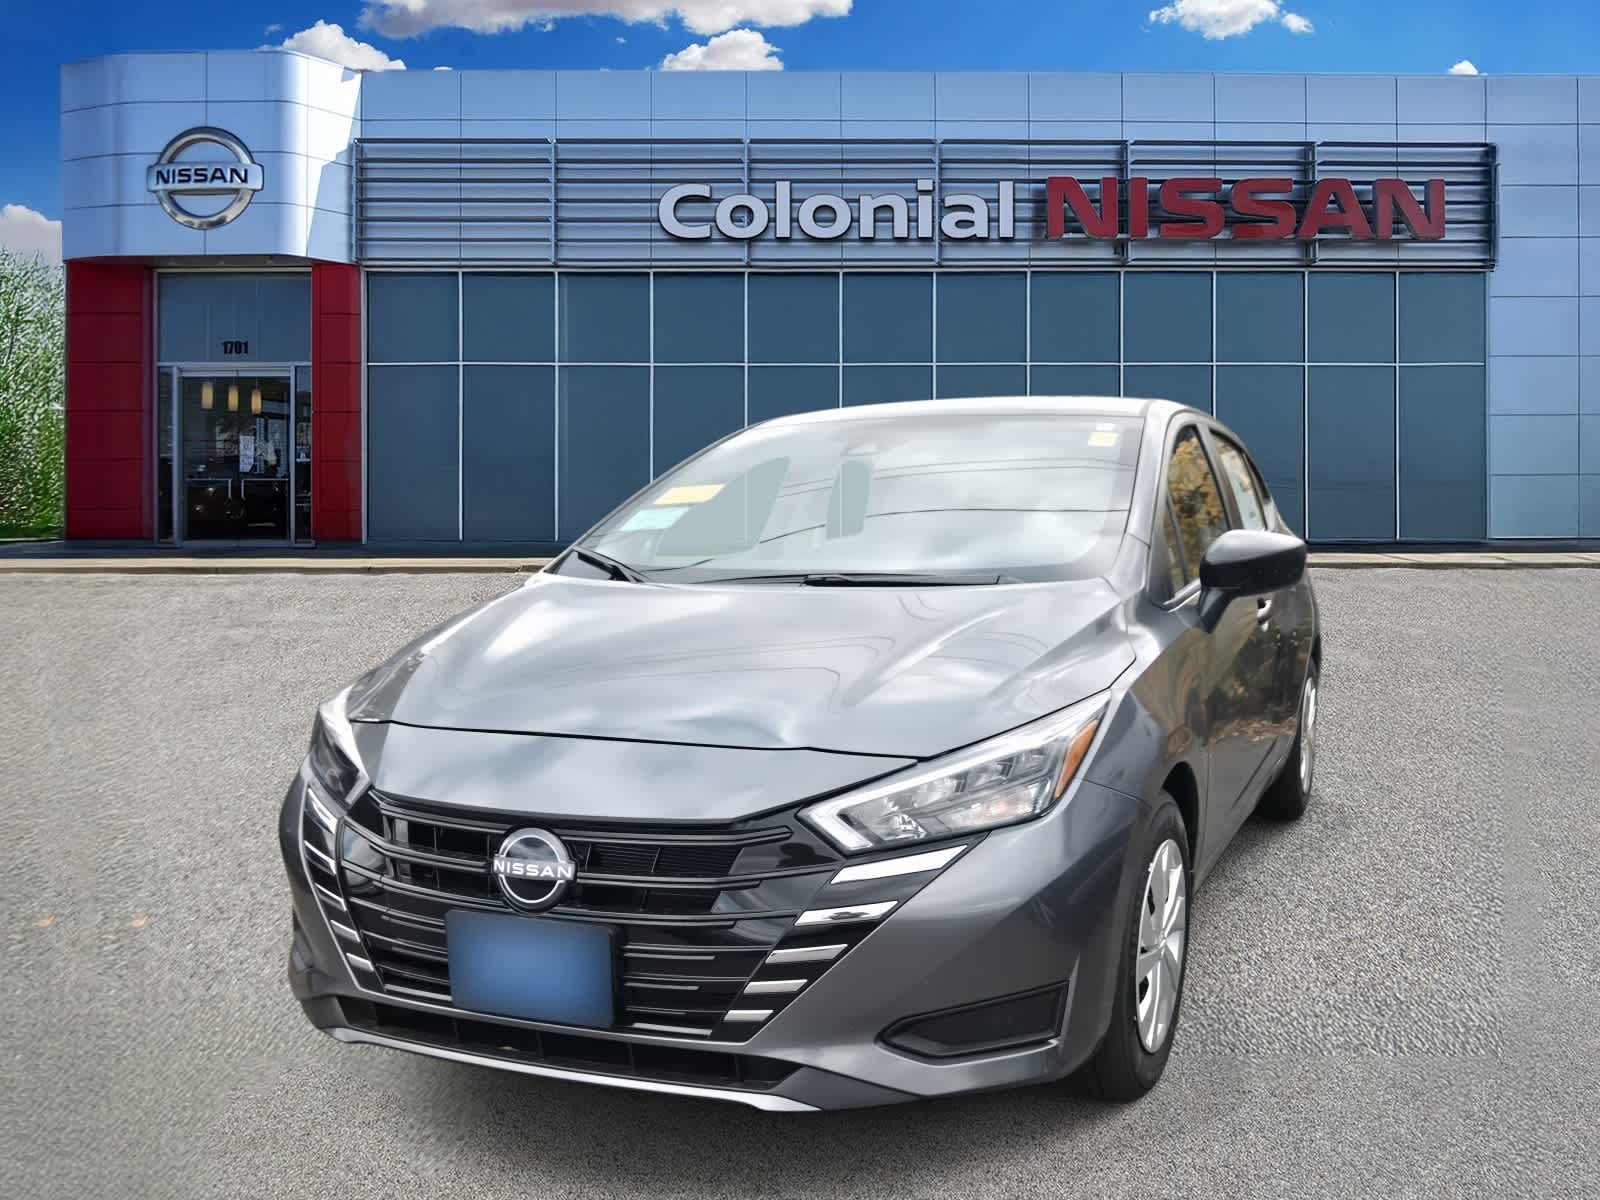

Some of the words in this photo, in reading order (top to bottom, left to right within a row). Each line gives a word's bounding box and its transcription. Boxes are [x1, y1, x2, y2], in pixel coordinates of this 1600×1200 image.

[155, 167, 249, 185] NISSAN
[658, 179, 1015, 239] Colonial
[1046, 176, 1446, 240] NISSAN
[222, 340, 249, 355] 1701
[493, 859, 572, 878] NISSAN
